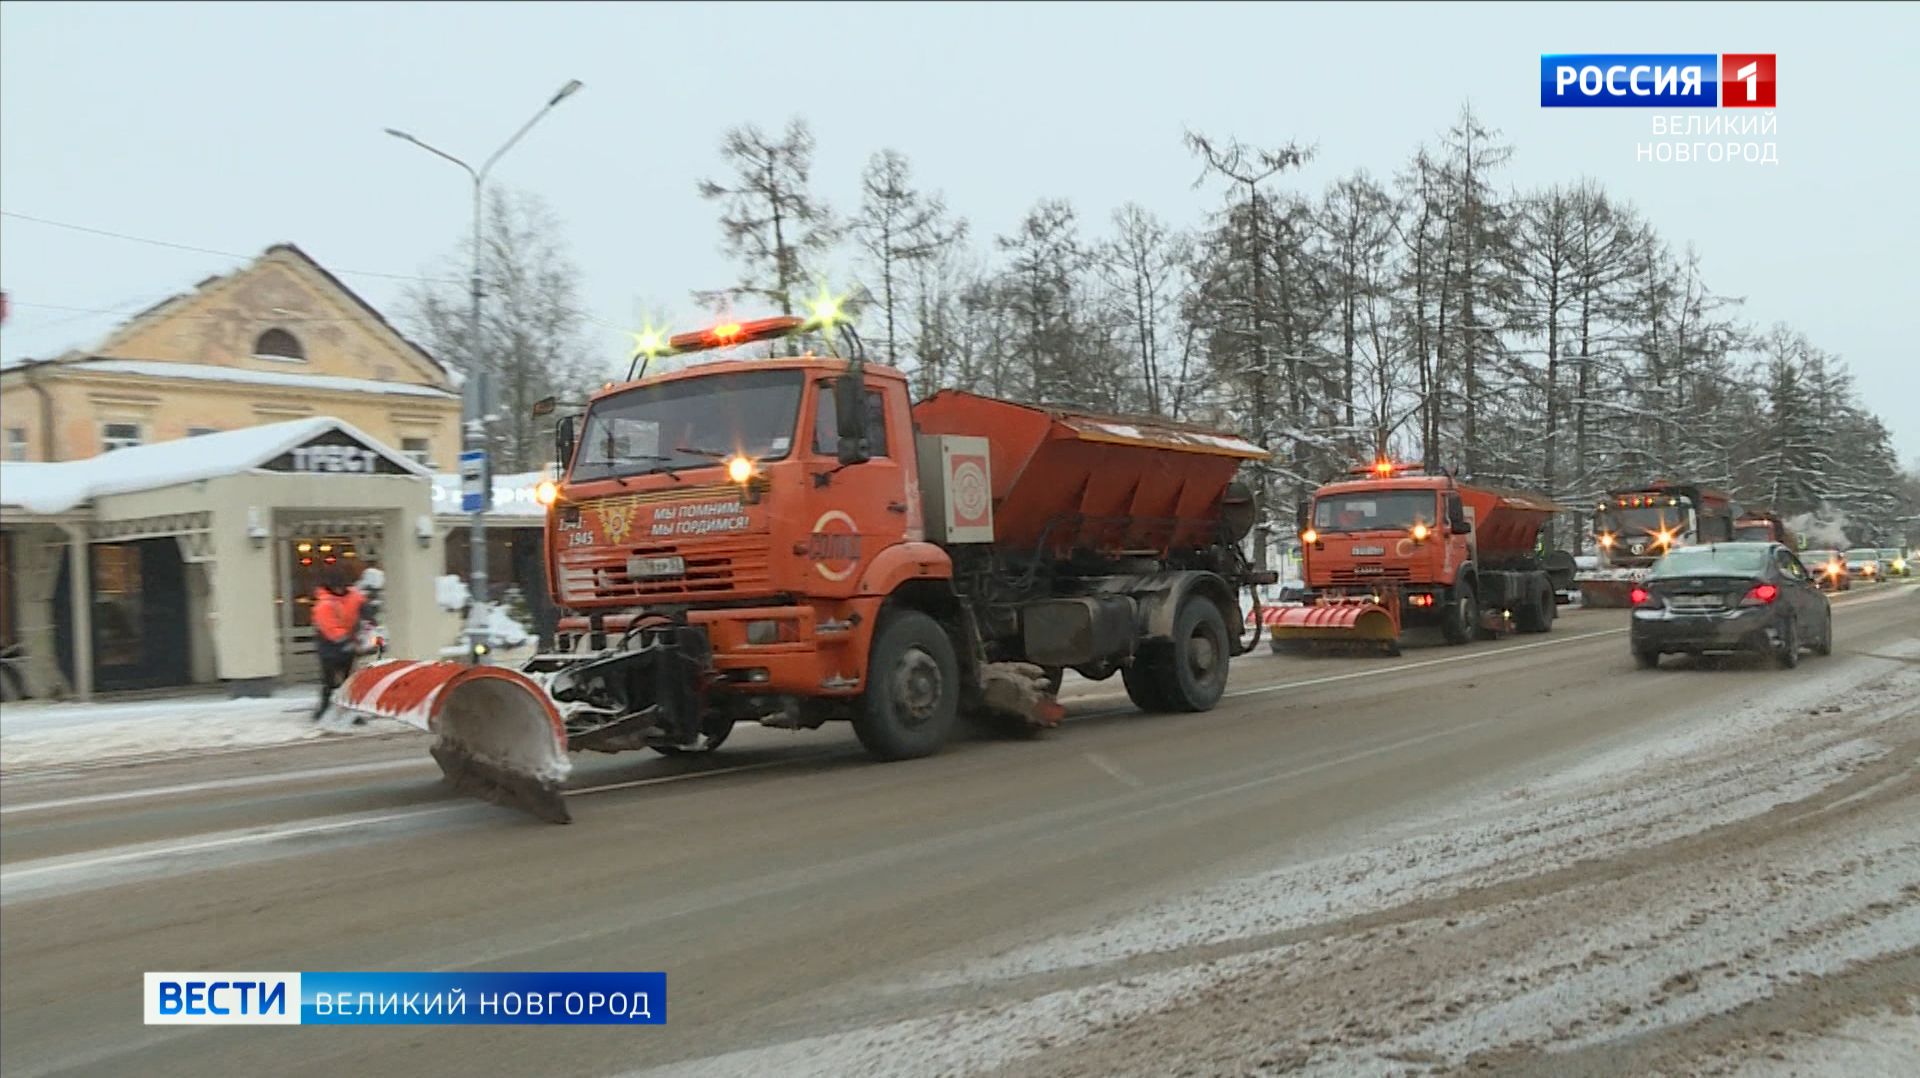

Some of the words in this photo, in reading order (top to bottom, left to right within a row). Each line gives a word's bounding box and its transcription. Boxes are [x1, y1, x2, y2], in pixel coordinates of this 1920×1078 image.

[293, 445, 378, 473] ТРЕСТ
[654, 507, 676, 520] МЫ
[651, 522, 674, 535] МЫ
[676, 516, 749, 535] ГОРДИМСЯ!
[568, 530, 594, 546] 1945
